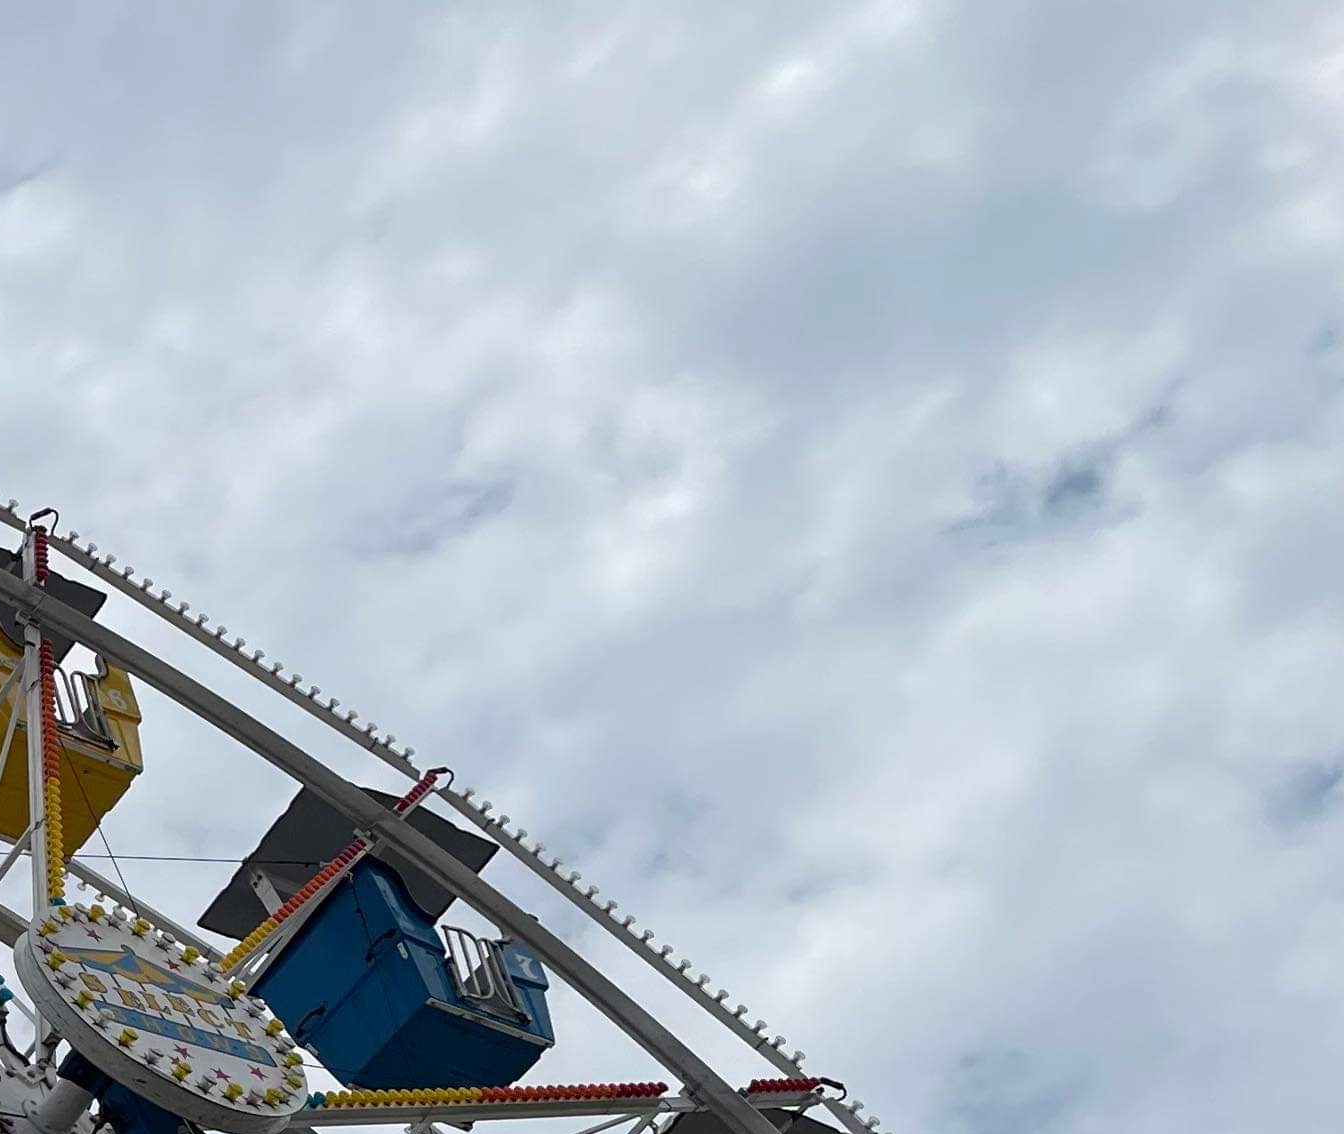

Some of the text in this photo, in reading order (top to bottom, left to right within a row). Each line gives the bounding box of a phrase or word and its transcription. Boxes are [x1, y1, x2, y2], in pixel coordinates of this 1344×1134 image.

[106, 688, 128, 710] 6
[515, 953, 538, 979] 7
[78, 971, 256, 1041] SELECT
